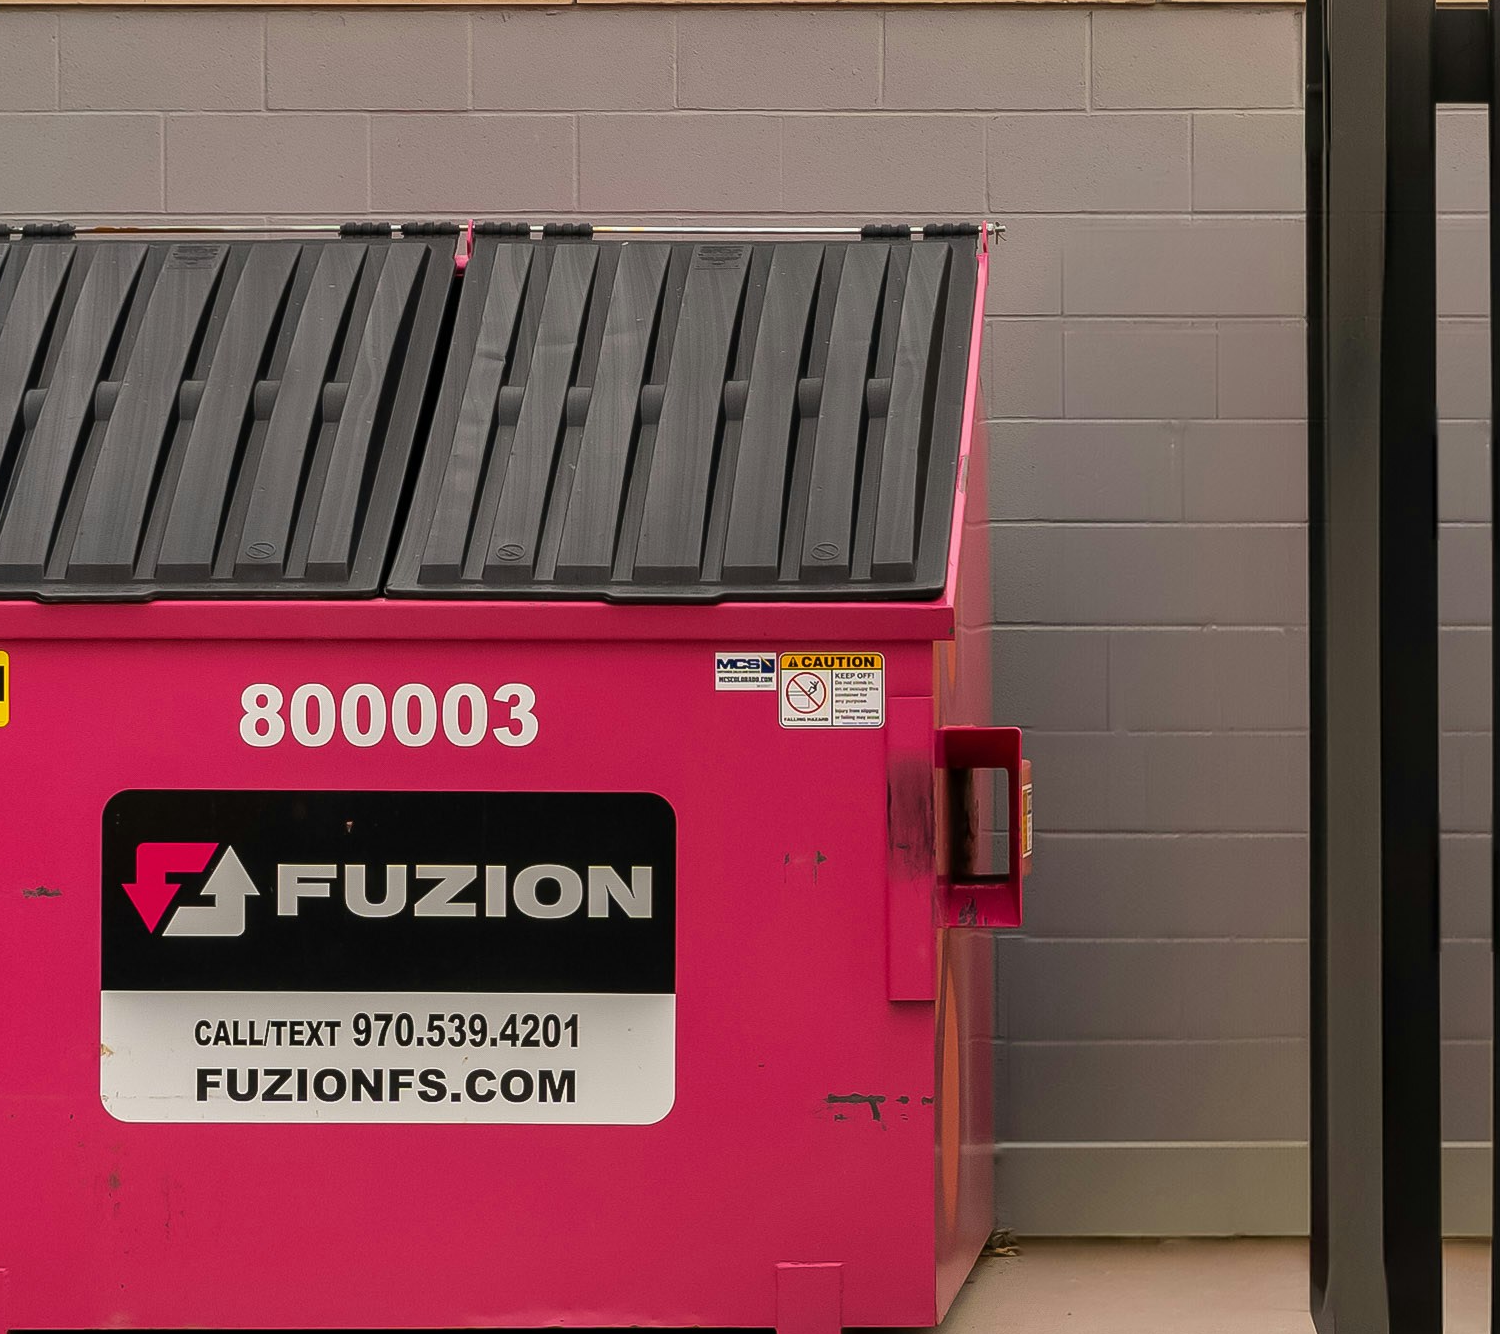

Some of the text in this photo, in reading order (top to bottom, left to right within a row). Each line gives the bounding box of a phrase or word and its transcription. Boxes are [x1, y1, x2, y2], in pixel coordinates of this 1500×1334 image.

[717, 659, 760, 669] MCS
[801, 657, 875, 667] CAUTION
[239, 682, 539, 747] 800003
[277, 863, 653, 918] FUZION
[195, 1012, 578, 1048] CALL/TEXT 970.539.4201
[196, 1068, 576, 1103] FUZIONFS.COM
